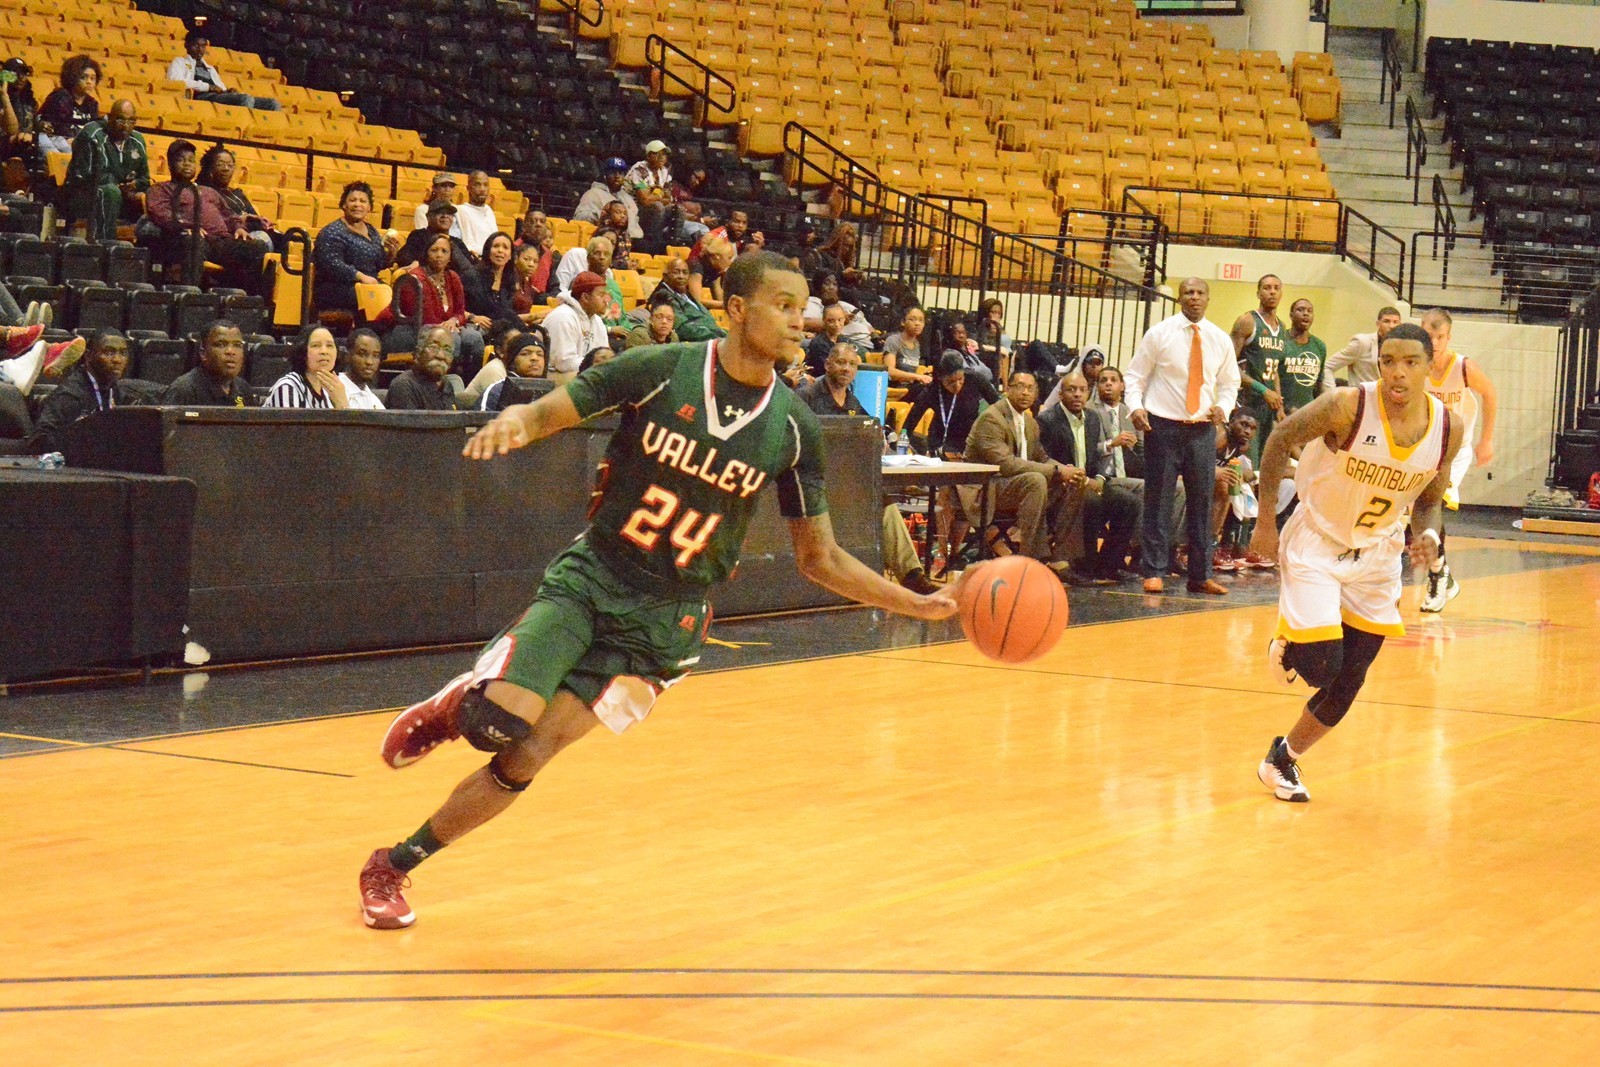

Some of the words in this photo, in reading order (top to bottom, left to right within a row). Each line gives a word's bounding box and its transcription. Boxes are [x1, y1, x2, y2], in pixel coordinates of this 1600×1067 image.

[1223, 263, 1243, 279] EXIT
[1258, 336, 1285, 351] VALLE
[1430, 391, 1461, 404] BLING
[642, 421, 767, 497] VALLEY
[1346, 456, 1425, 492] GRAMBLIN
[620, 484, 723, 567] 24
[1354, 496, 1393, 528] 2
